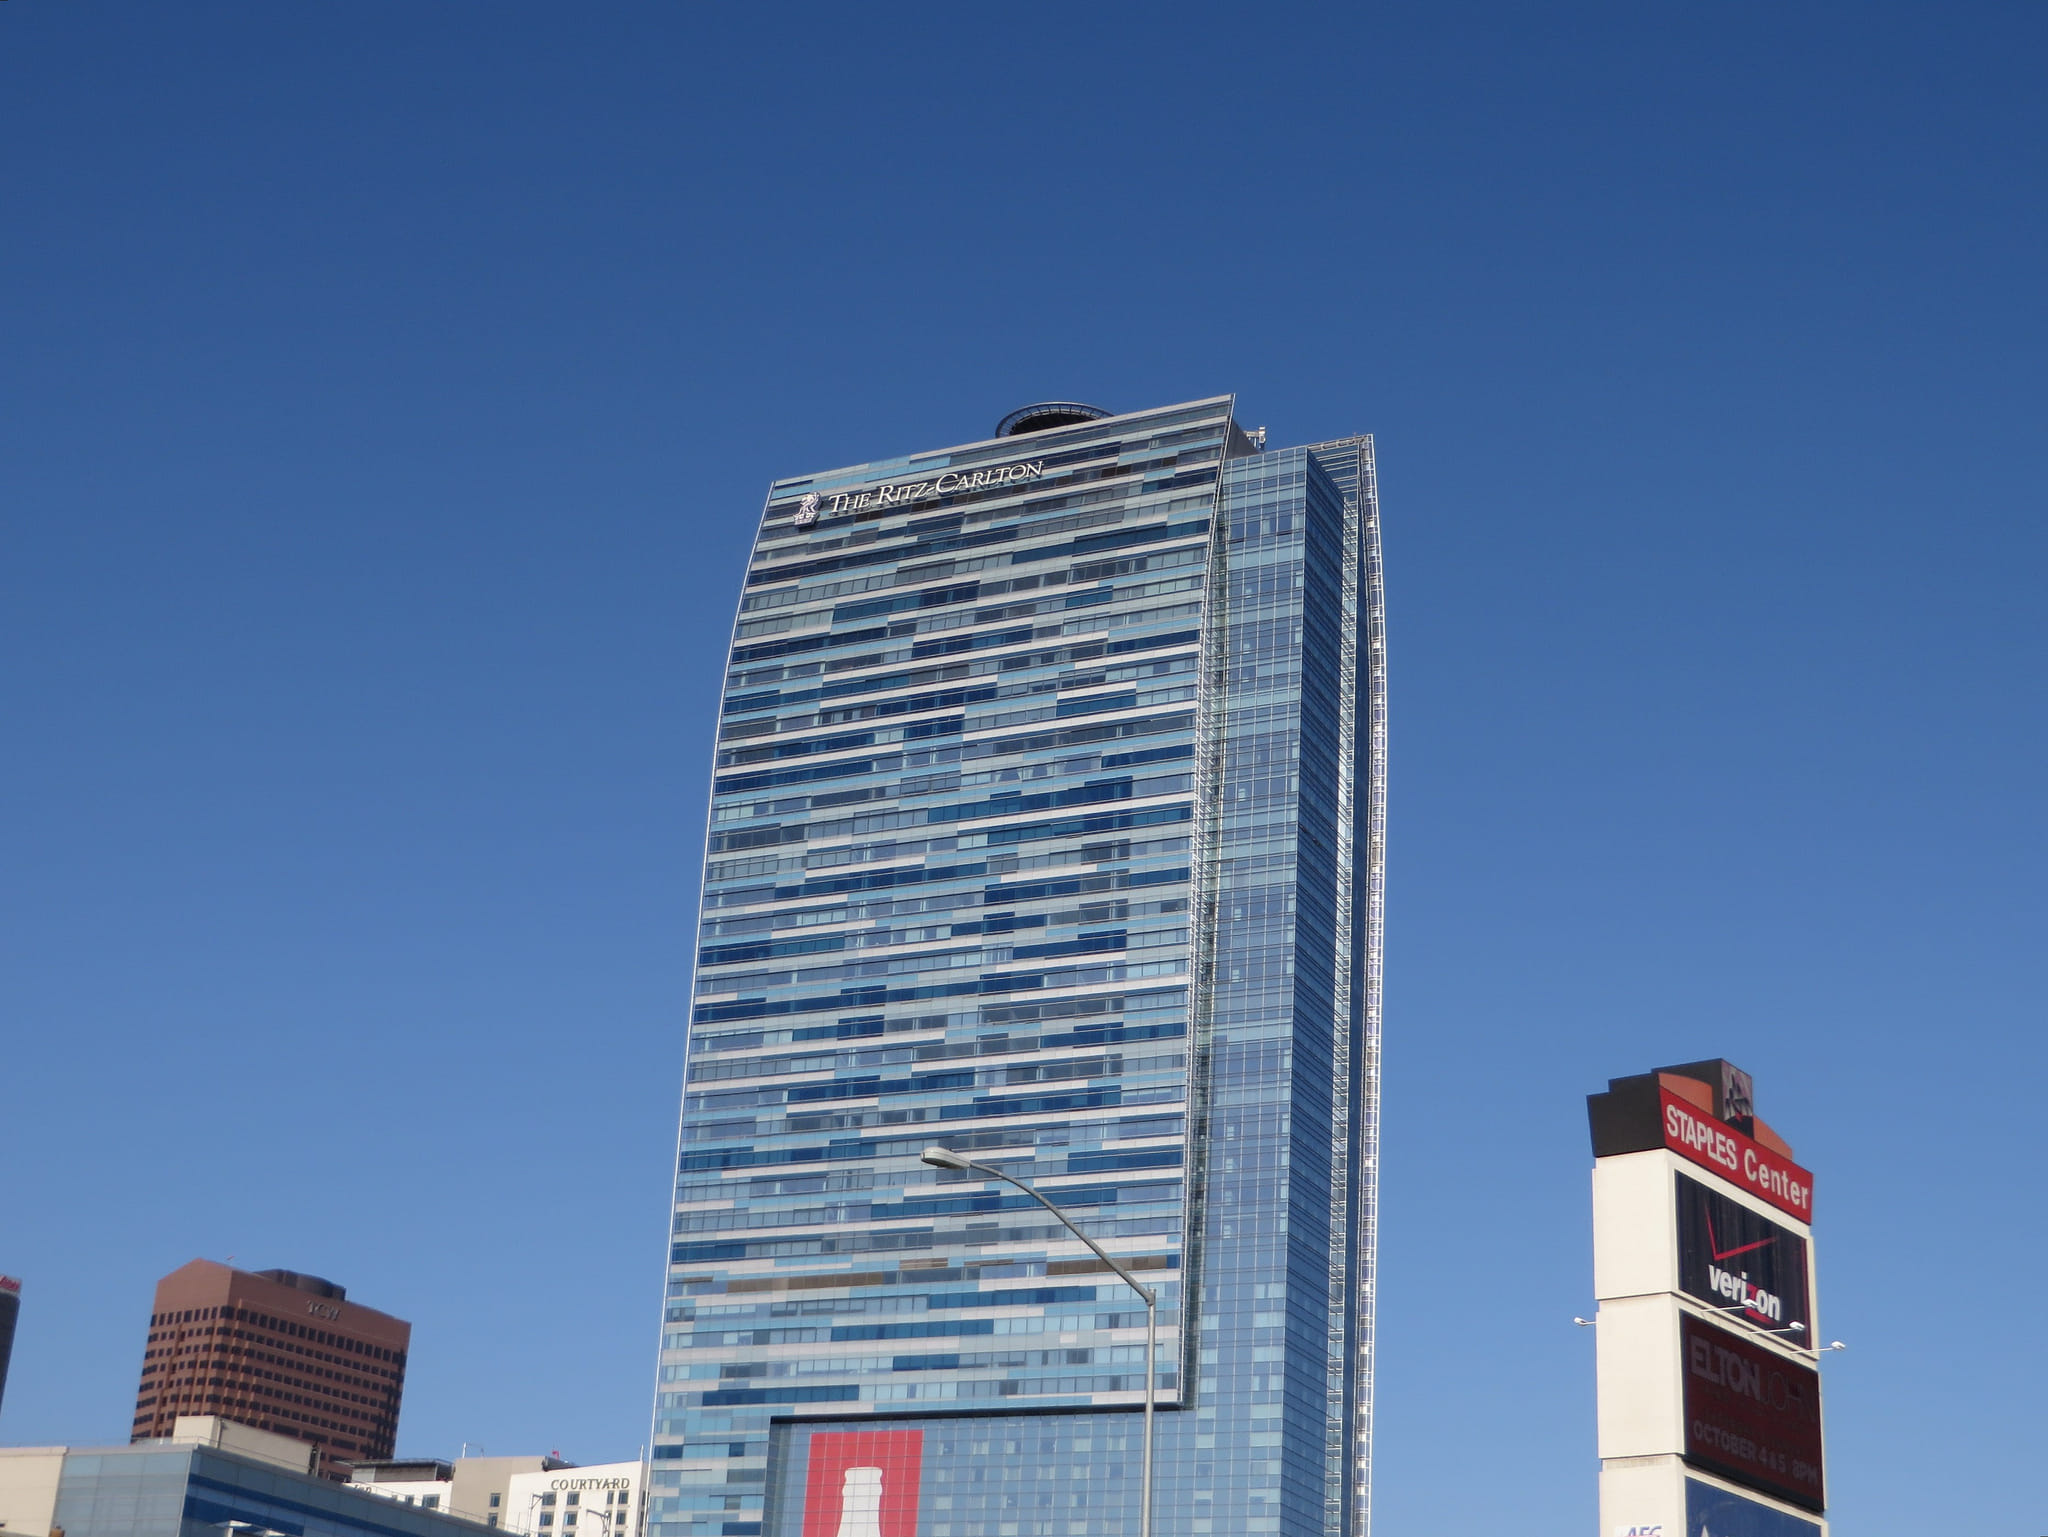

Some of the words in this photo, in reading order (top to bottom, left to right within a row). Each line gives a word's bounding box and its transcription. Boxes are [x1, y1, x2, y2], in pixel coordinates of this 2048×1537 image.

[829, 492, 871, 514] THE
[878, 461, 1043, 505] RITZ-CARLTON
[1666, 1104, 1738, 1170] STAPLES
[1744, 1148, 1809, 1209] Center
[1708, 1264, 1780, 1321] verizon
[1690, 1334, 1761, 1401] ELTON
[1693, 1420, 1757, 1462] OCTOBER
[551, 1477, 630, 1491] COURTYARD
